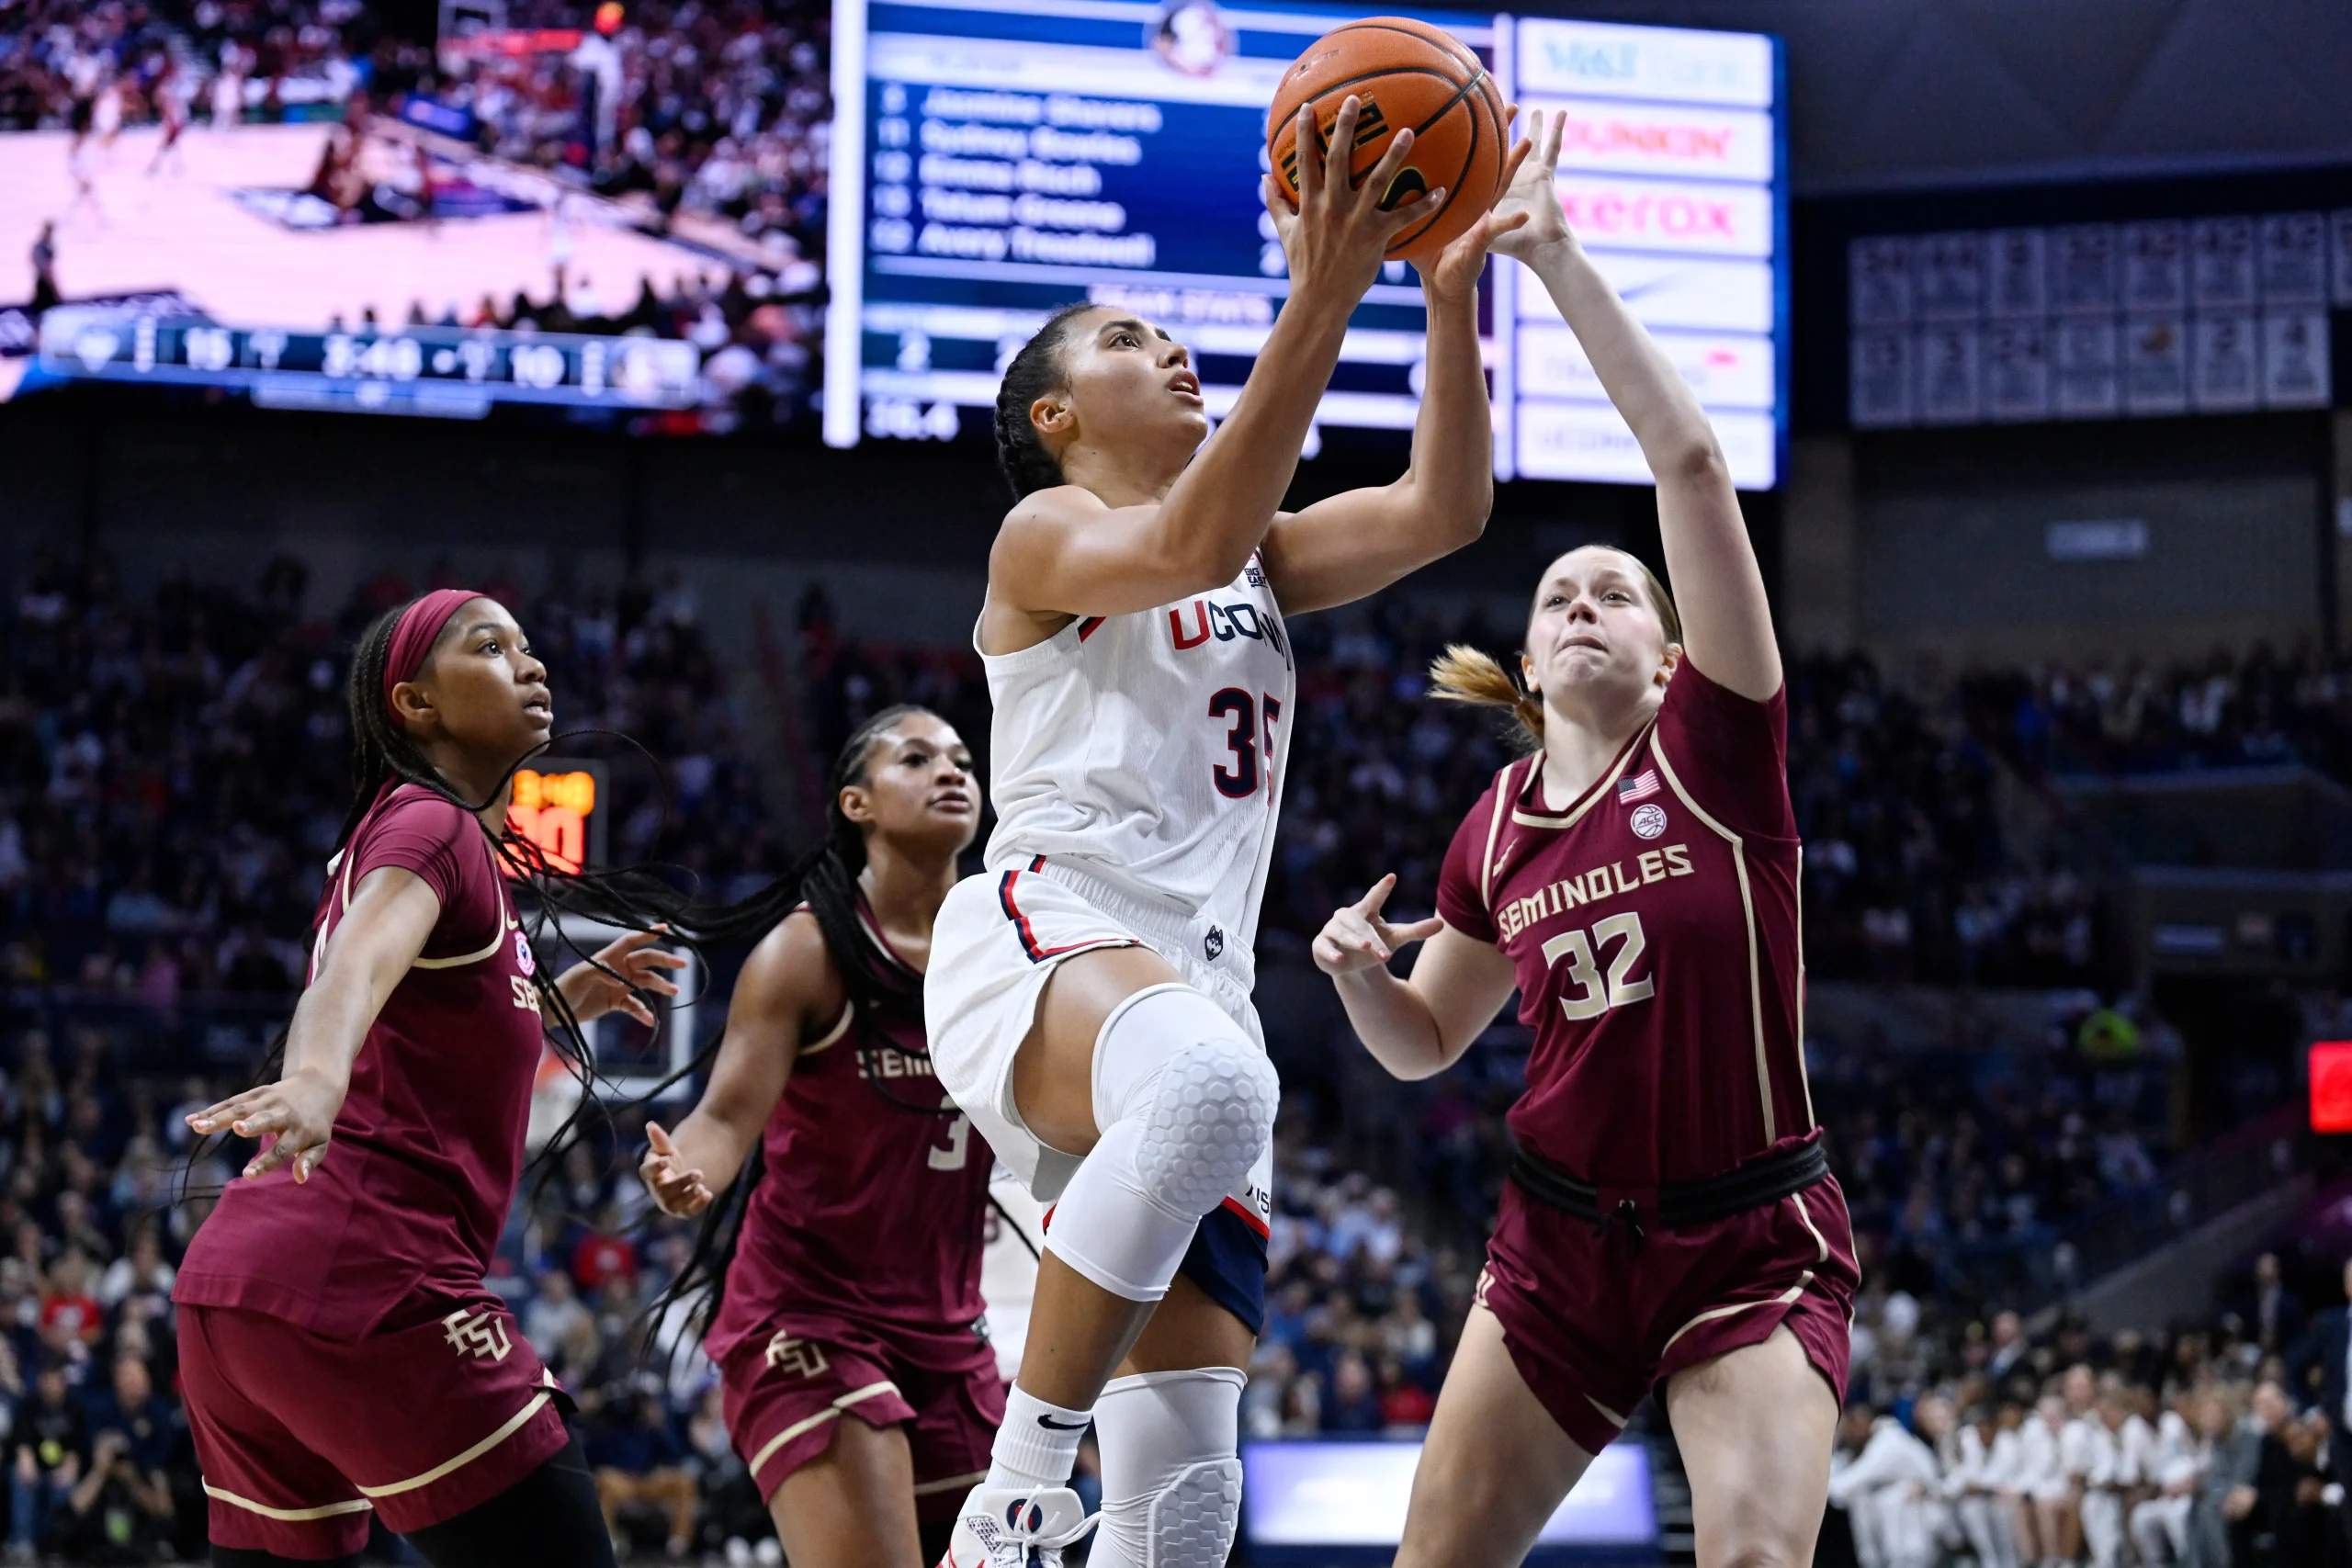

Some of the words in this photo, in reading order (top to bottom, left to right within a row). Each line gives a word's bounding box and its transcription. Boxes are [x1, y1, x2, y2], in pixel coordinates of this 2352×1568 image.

[1244, 567, 1261, 576] BIG
[1248, 576, 1267, 585] EAST
[1637, 813, 1662, 826] ACC
[1498, 843, 1695, 944] SEMINOLES
[1542, 911, 1655, 1021] 32
[442, 1309, 513, 1361] FSU
[764, 1329, 829, 1378] FSU
